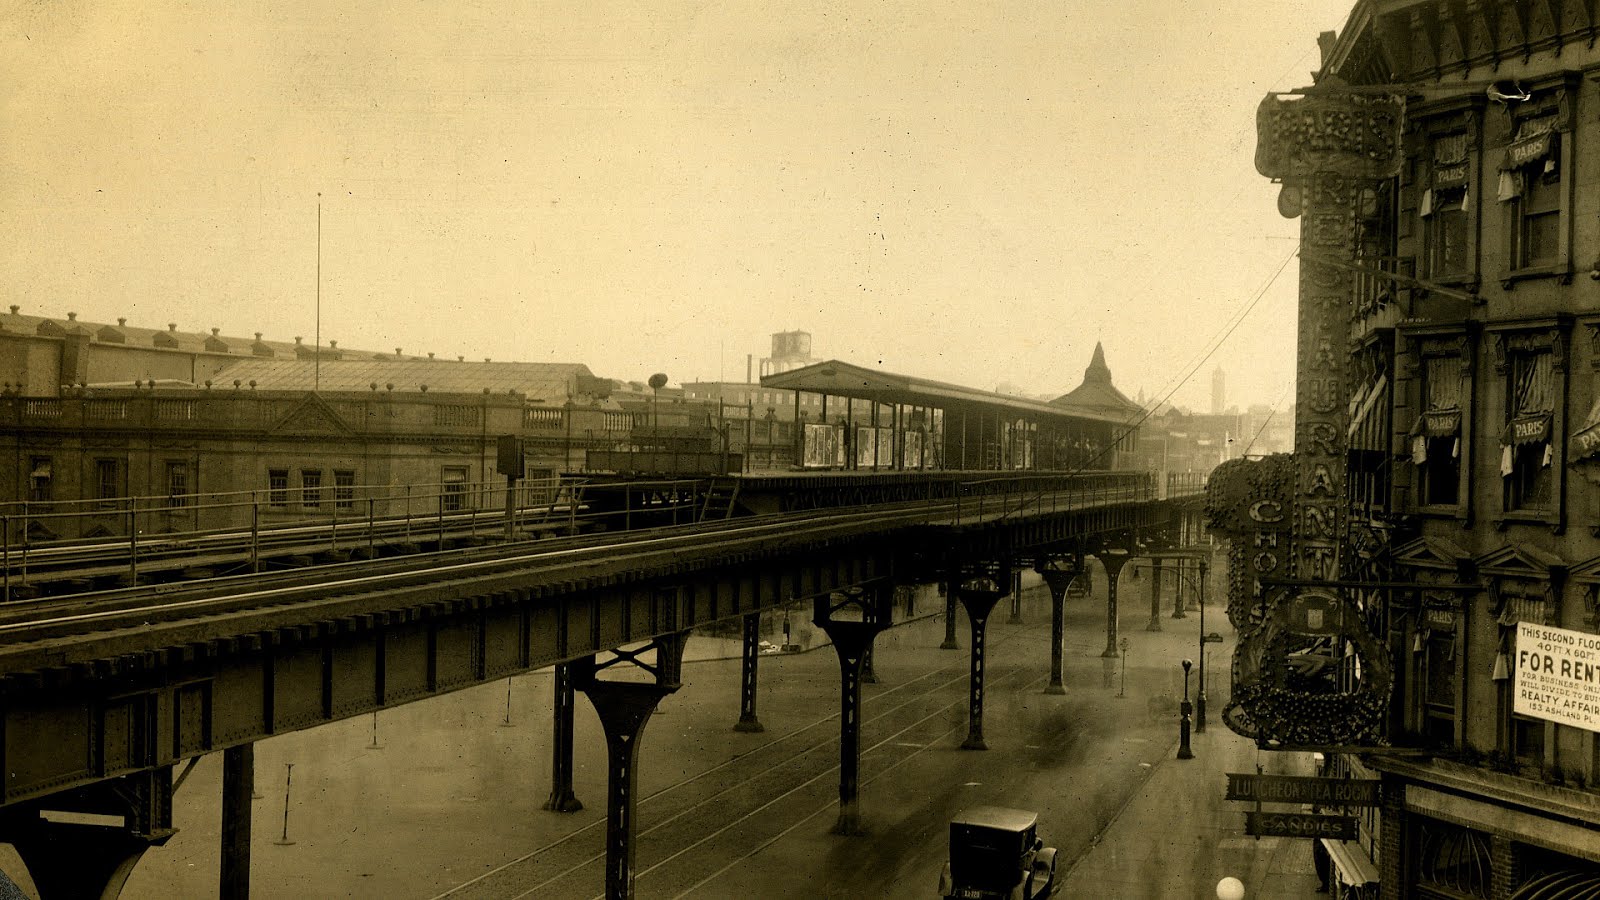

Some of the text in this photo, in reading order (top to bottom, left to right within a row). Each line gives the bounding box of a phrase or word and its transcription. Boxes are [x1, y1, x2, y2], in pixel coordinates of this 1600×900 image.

[1513, 139, 1544, 161] PARIS
[1437, 167, 1465, 184] PARIS
[1304, 171, 1345, 579] RESTAURANT
[1427, 416, 1454, 431] PARIS
[1515, 420, 1544, 438] PARIS
[1427, 609, 1454, 624] PARIS
[1521, 626, 1541, 639] THIS
[1542, 630, 1575, 646] SECOND
[1520, 650, 1554, 675] FOR
[1520, 679, 1540, 690] WILL
[1541, 684, 1570, 697] DIVIDE
[1572, 690, 1583, 699] TO
[1522, 671, 1600, 694] FOR BUSINESS ONL
[1521, 689, 1560, 706] REALTY
[1529, 702, 1543, 712] 153
[1545, 706, 1581, 721] ASHLAND
[1235, 779, 1298, 799] LUNCHEON
[1310, 782, 1331, 800] TEA
[1335, 783, 1372, 802] ROOM
[1260, 820, 1343, 833] CANDIES
